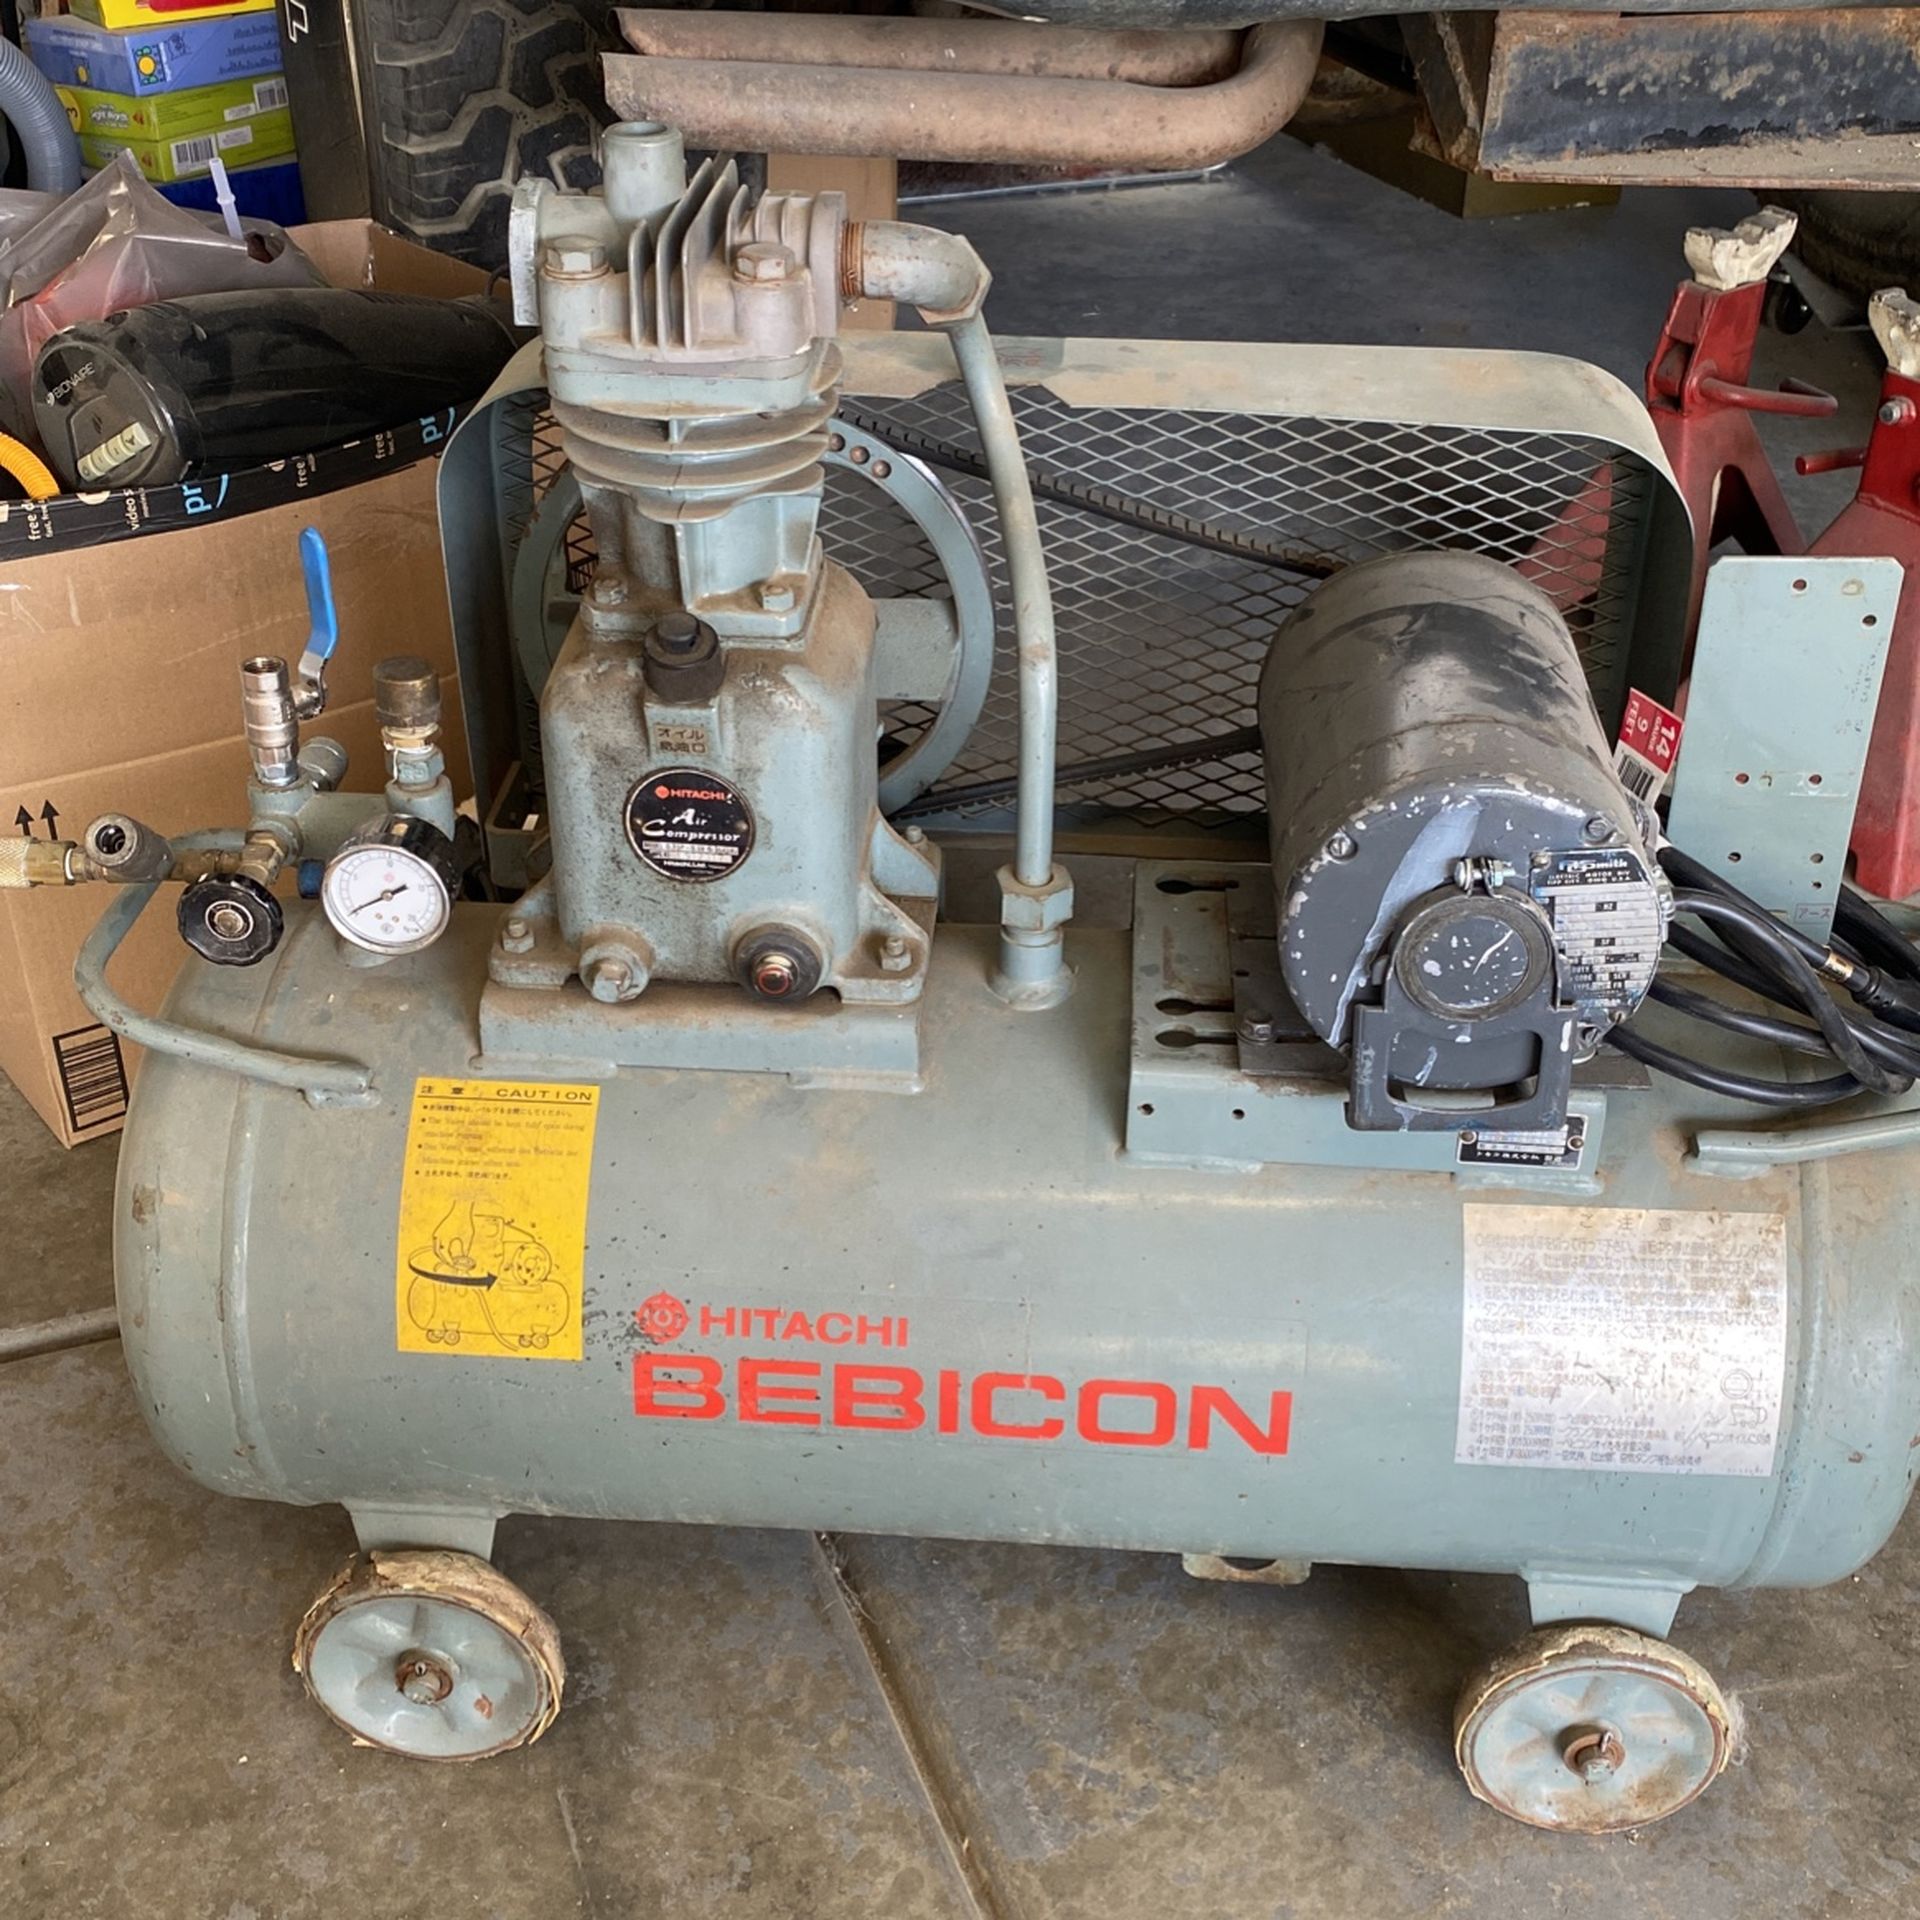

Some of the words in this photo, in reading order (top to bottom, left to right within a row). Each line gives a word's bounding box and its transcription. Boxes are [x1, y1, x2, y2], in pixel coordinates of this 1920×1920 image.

[52, 362, 95, 399] BIONAIRE
[296, 461, 308, 488] free
[28, 513, 41, 541] free
[125, 497, 140, 531] video
[1625, 700, 1639, 737] FEET
[1637, 716, 1648, 732] 9
[658, 728, 705, 740] オイル
[1656, 726, 1675, 759] 14
[670, 788, 725, 800] HITACHI
[642, 819, 741, 841] Compressor
[672, 808, 708, 825] Air
[1799, 907, 1831, 919] アース
[496, 1088, 593, 1101] CAUTION
[700, 1305, 908, 1347] HITACHI
[633, 1354, 1292, 1455] BEBICON
